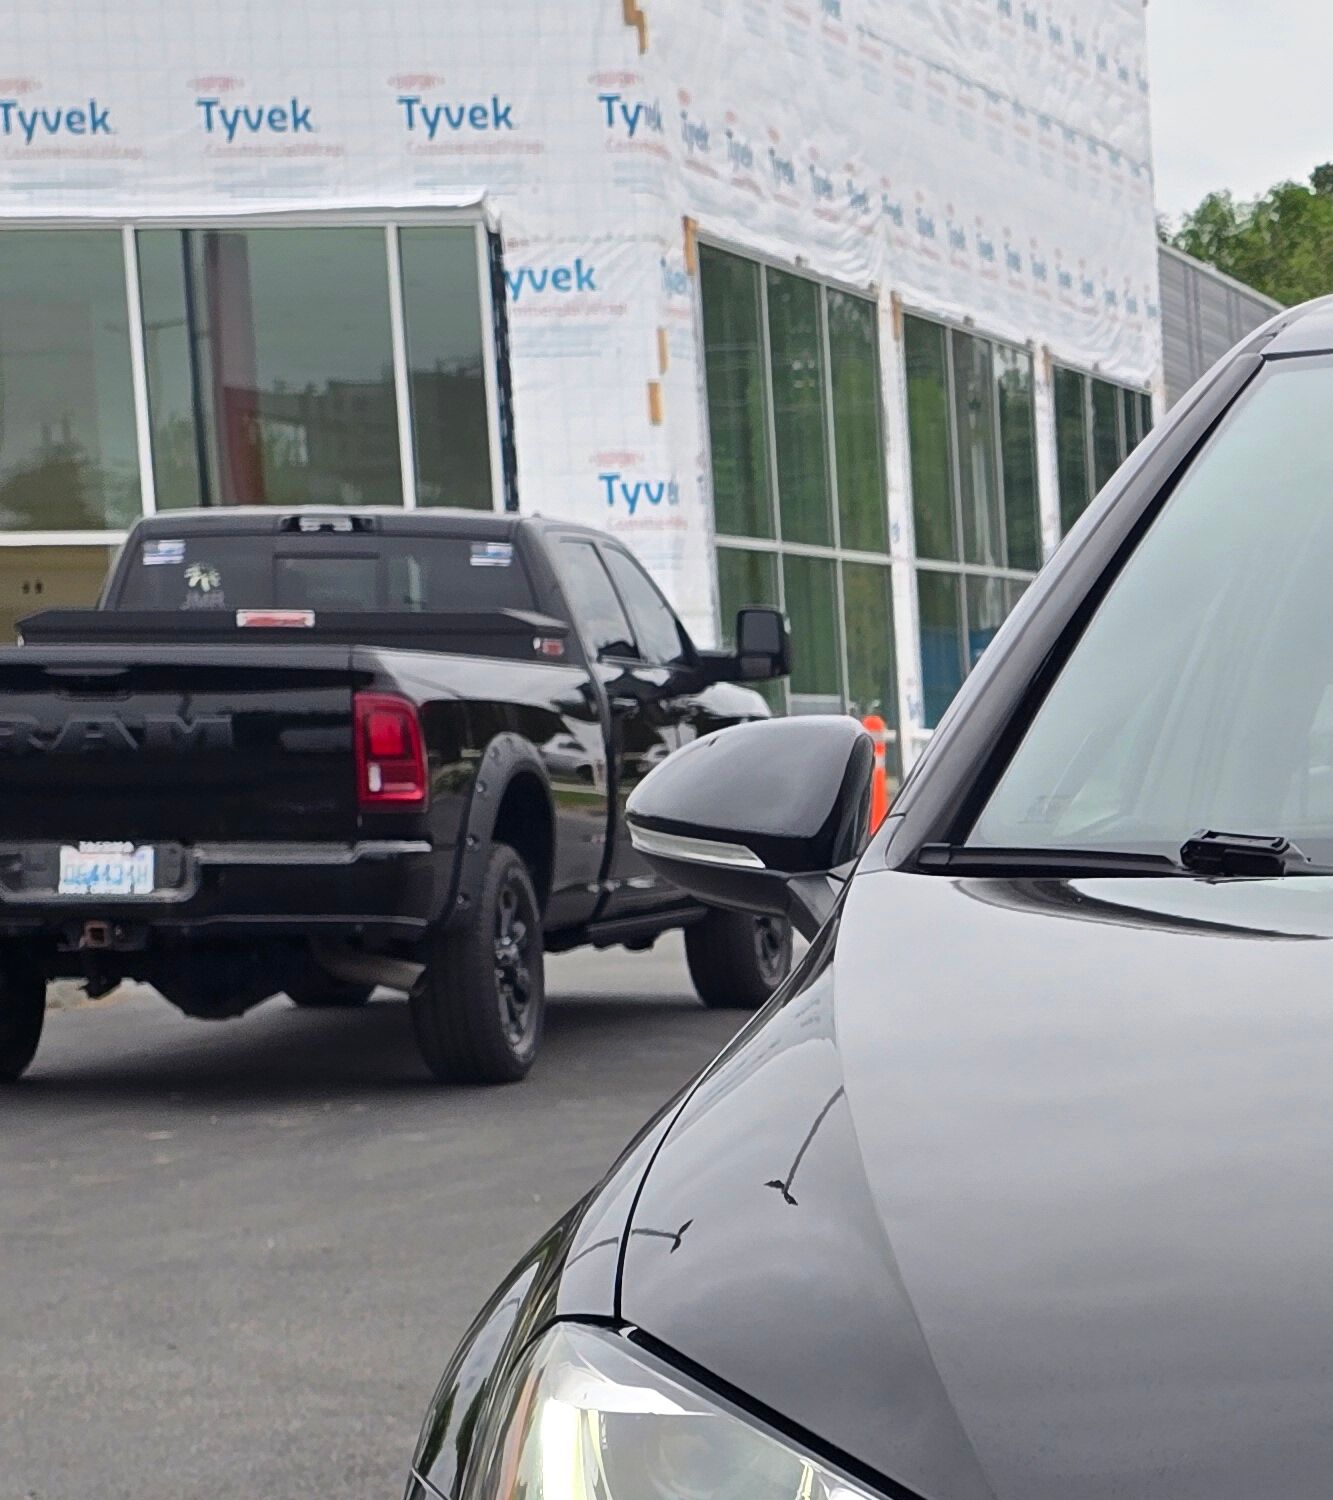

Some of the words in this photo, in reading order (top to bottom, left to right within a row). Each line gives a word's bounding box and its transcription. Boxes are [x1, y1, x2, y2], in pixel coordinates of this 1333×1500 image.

[0, 97, 113, 146] Tyvek
[196, 96, 314, 143] Tyvek
[396, 94, 514, 140] Tyvek
[504, 258, 596, 302] yvek
[598, 472, 680, 515] Tyv
